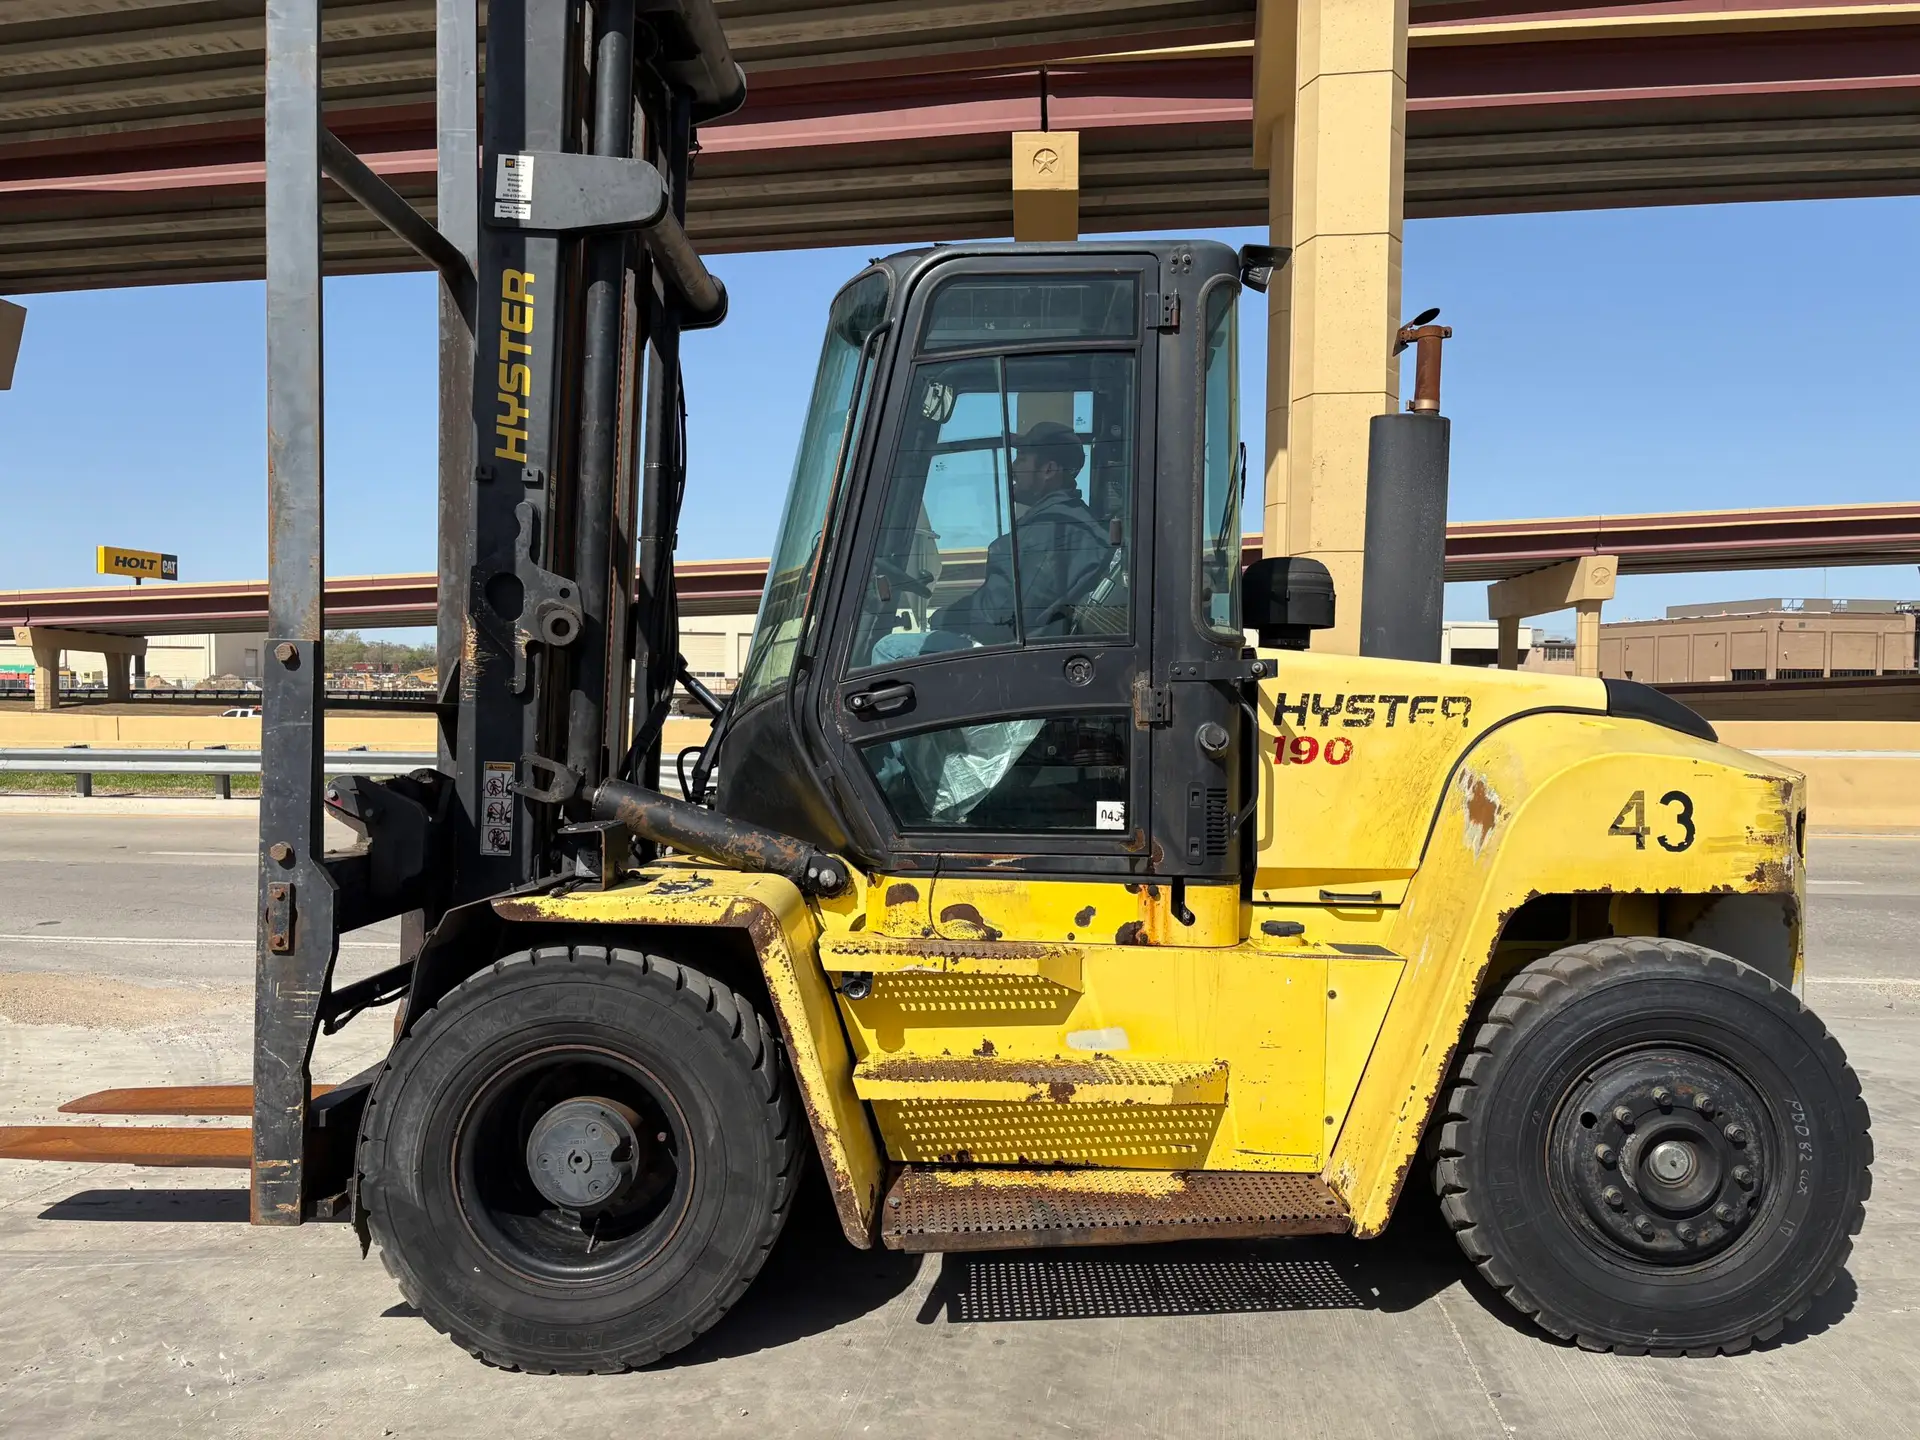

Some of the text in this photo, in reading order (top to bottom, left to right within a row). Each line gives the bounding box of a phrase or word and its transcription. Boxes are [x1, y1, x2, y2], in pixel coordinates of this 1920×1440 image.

[495, 268, 535, 463] HYSTER
[114, 556, 176, 574] HOLT CAT
[1273, 692, 1472, 728] HYSTER
[1273, 735, 1353, 765] 190
[1608, 790, 1696, 853] 43
